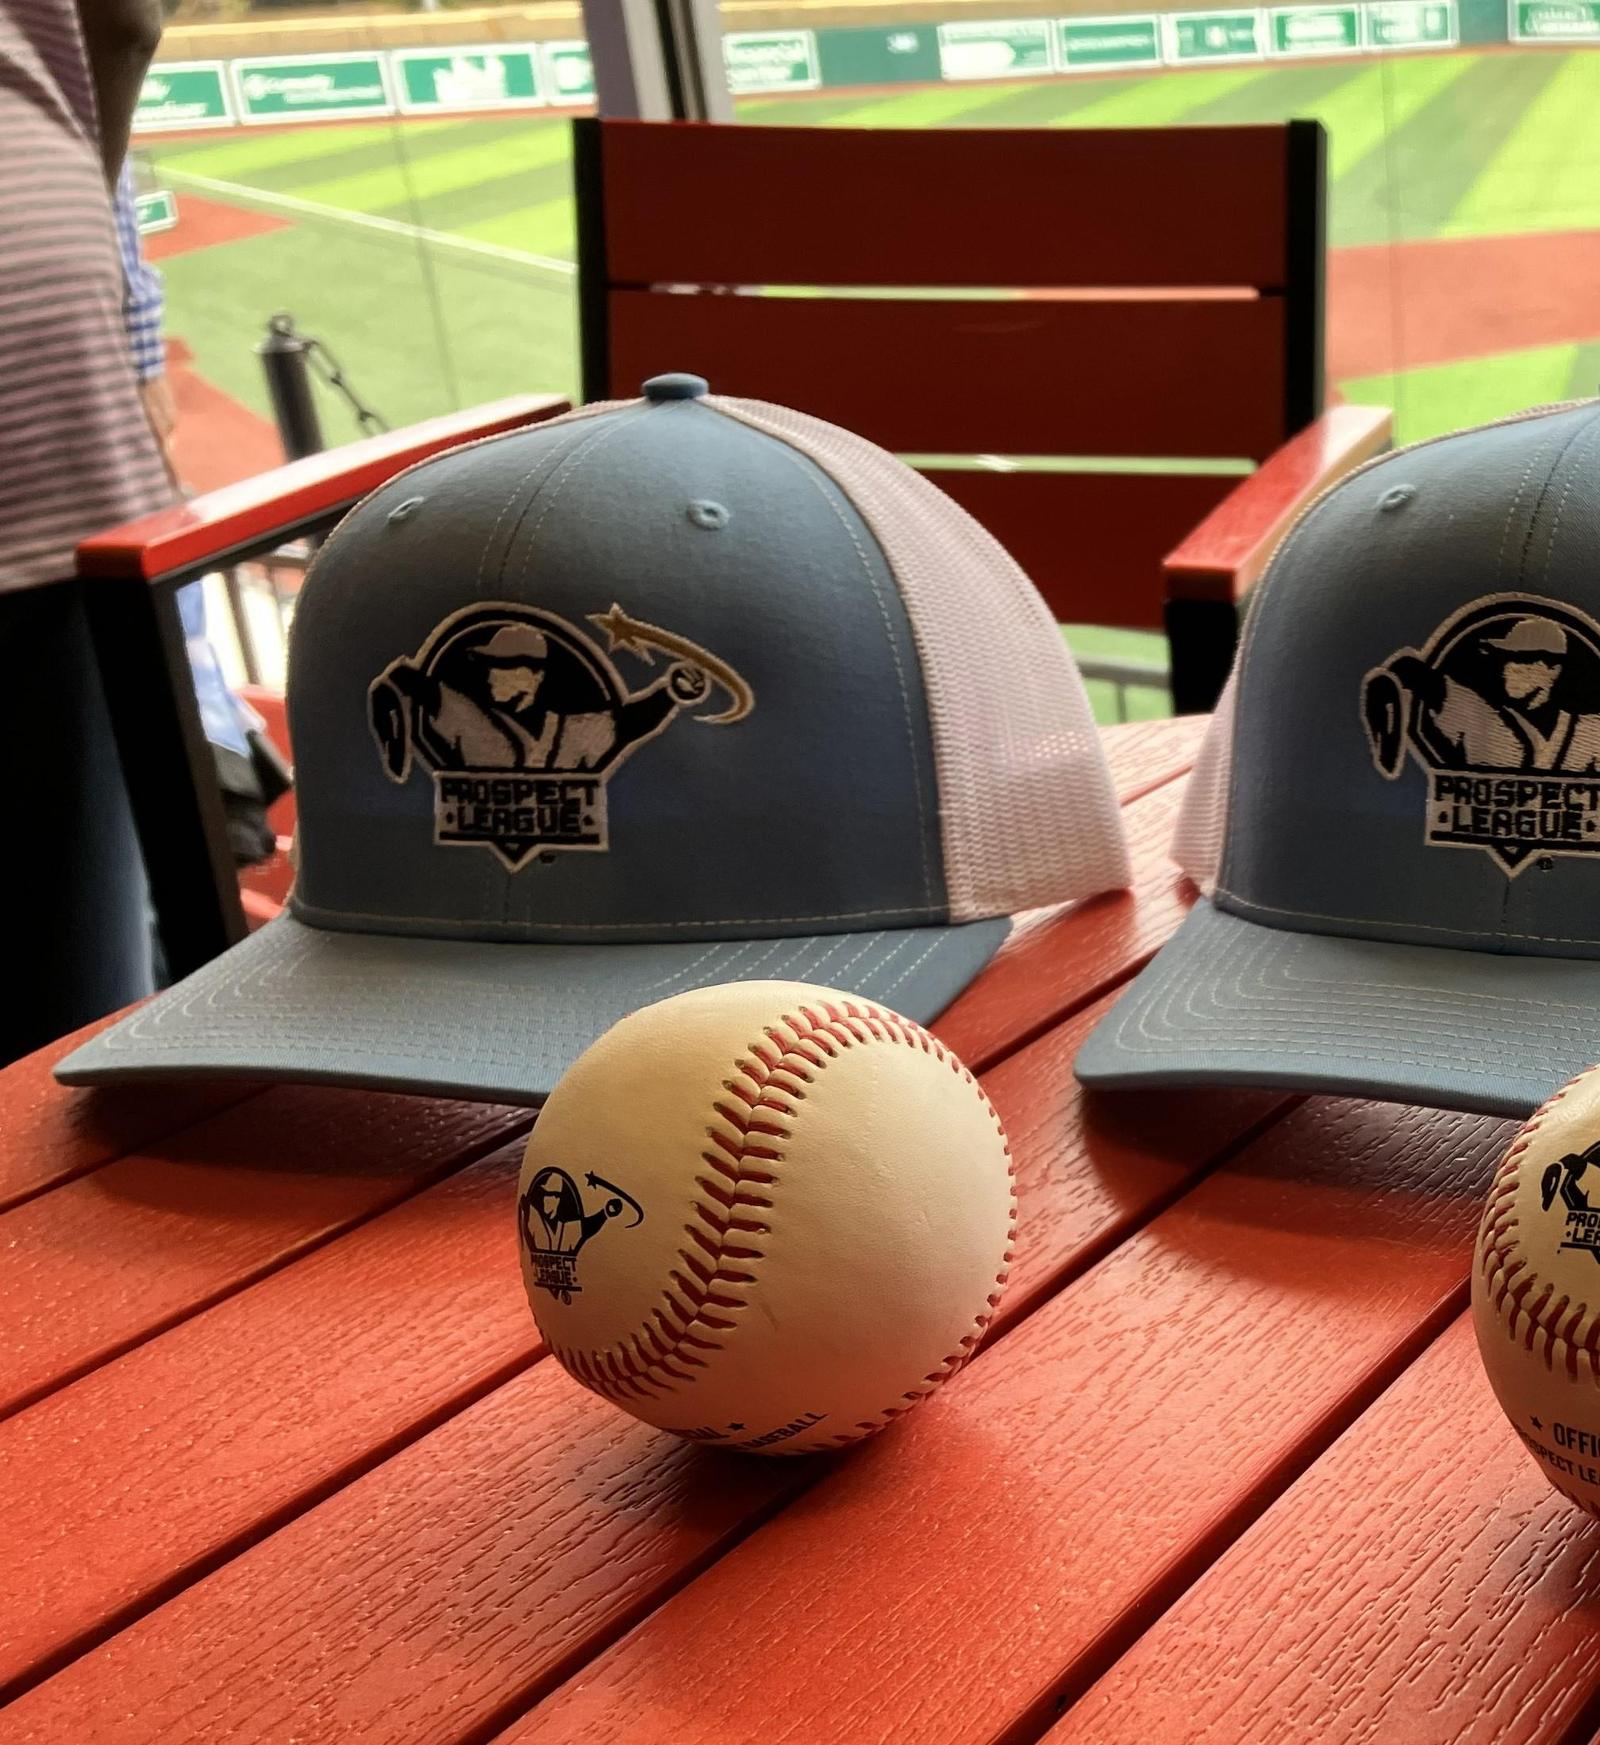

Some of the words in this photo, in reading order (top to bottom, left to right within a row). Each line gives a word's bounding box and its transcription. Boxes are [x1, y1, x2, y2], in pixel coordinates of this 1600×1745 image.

[441, 779, 600, 806] PROSPECT
[458, 805, 582, 835] LEAGUE
[1452, 805, 1583, 840] LEAGUE
